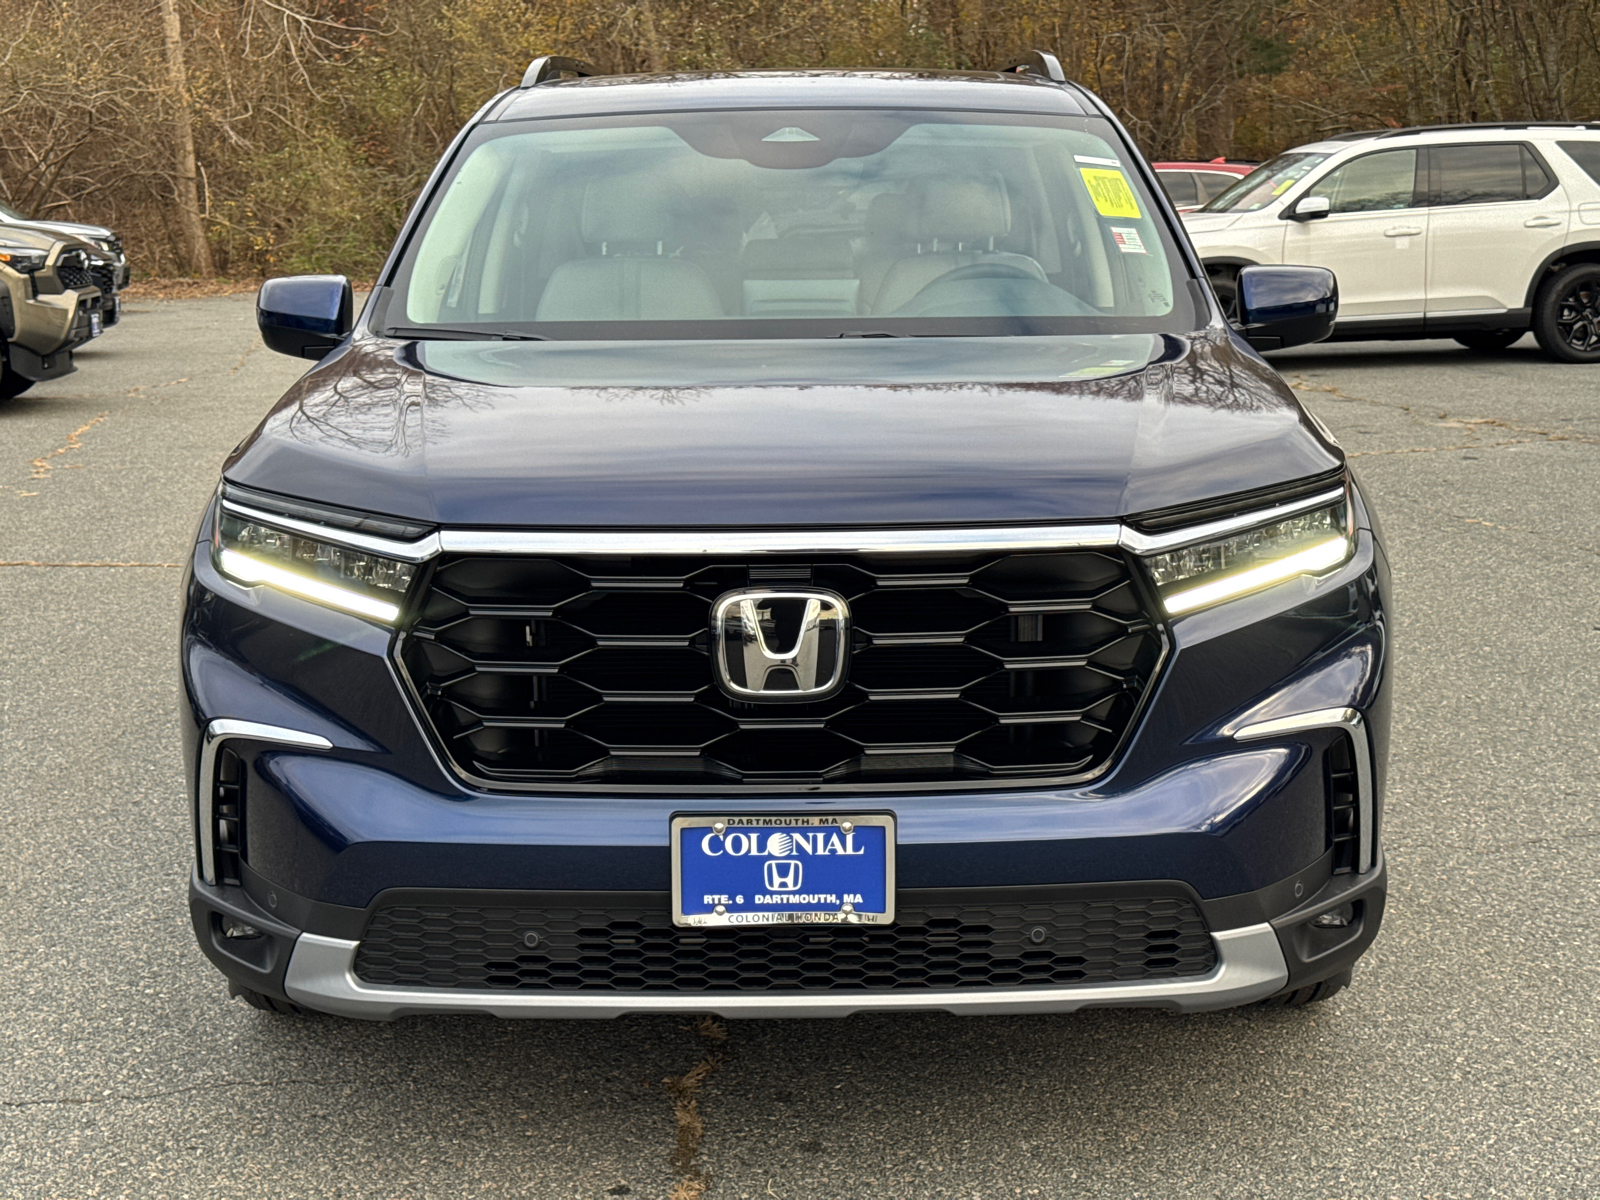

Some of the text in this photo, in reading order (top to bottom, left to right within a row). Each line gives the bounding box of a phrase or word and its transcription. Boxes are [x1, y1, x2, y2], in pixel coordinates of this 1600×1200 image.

[819, 817, 839, 825] MA
[701, 832, 865, 857] COLONIAL
[703, 893, 863, 905] RTE. 6 DARTMOUTH, MA
[727, 912, 840, 924] COLONIAL HONDA
